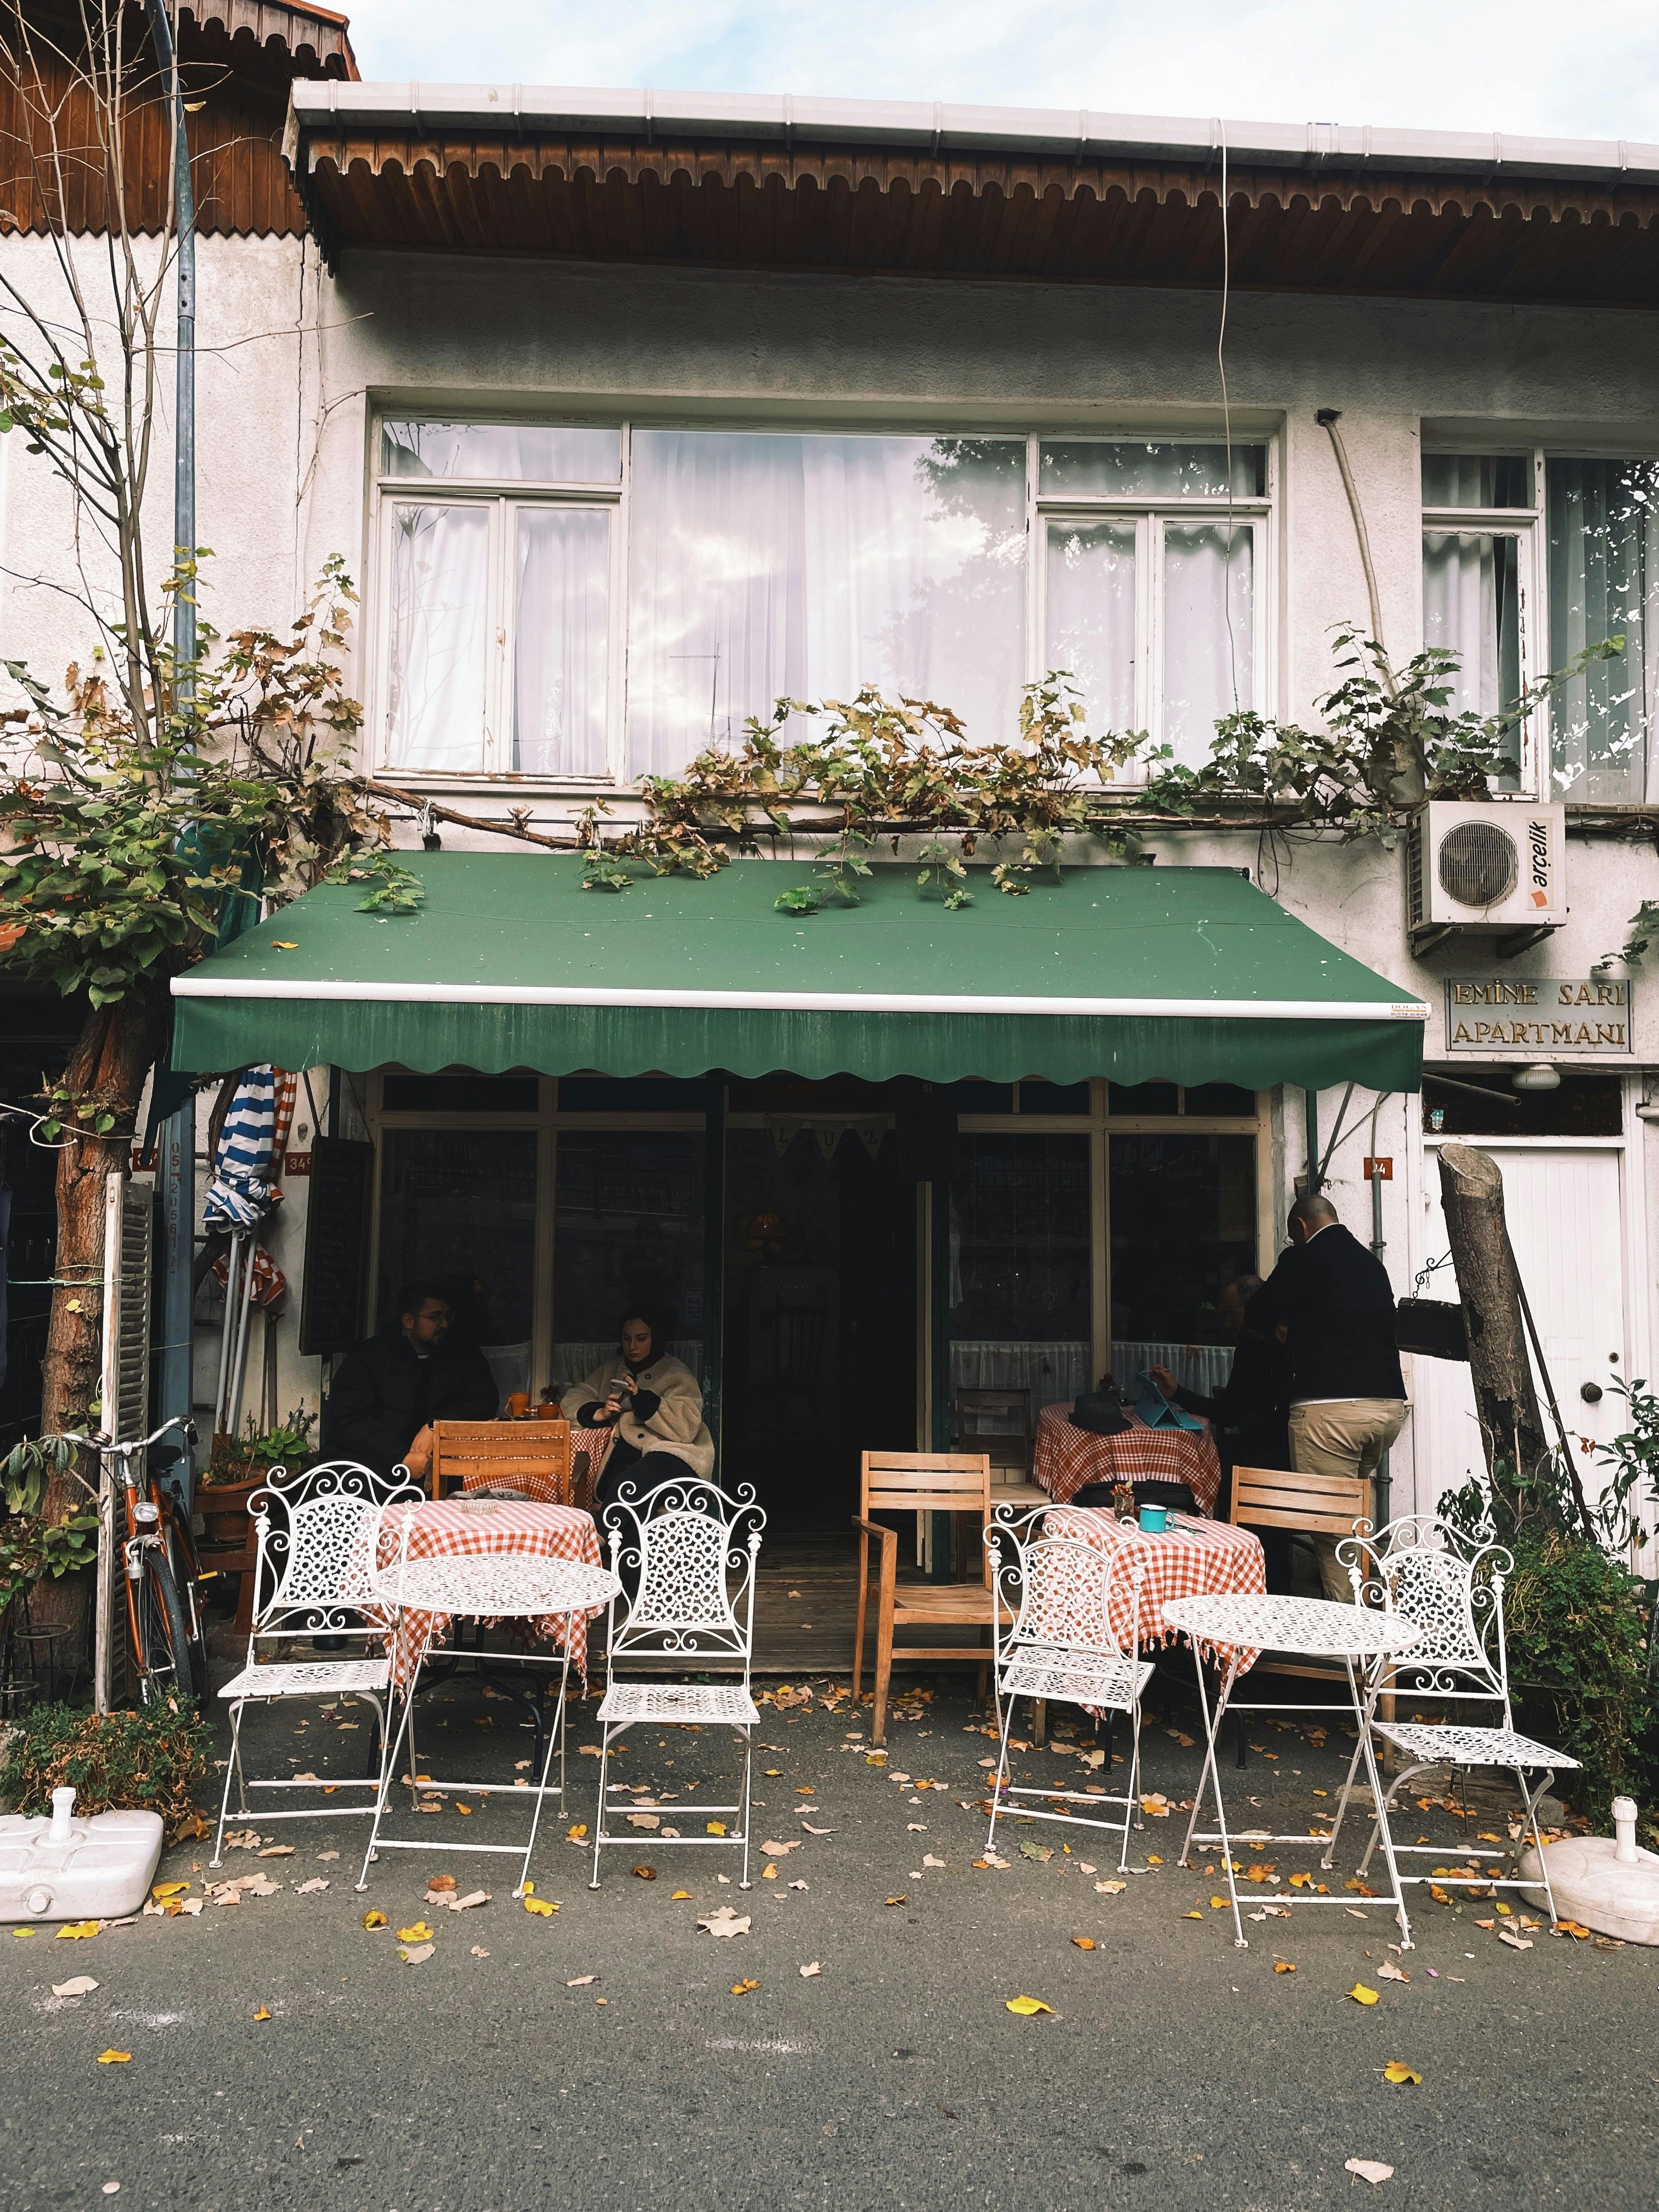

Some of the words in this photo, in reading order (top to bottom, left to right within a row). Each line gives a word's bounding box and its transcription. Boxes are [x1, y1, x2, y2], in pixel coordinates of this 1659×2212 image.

[1528, 821, 1551, 888] arçelik
[1454, 980, 1538, 1005] EMİNE
[1558, 984, 1627, 1006] SARI
[1452, 1021, 1626, 1044] APARTMANI
